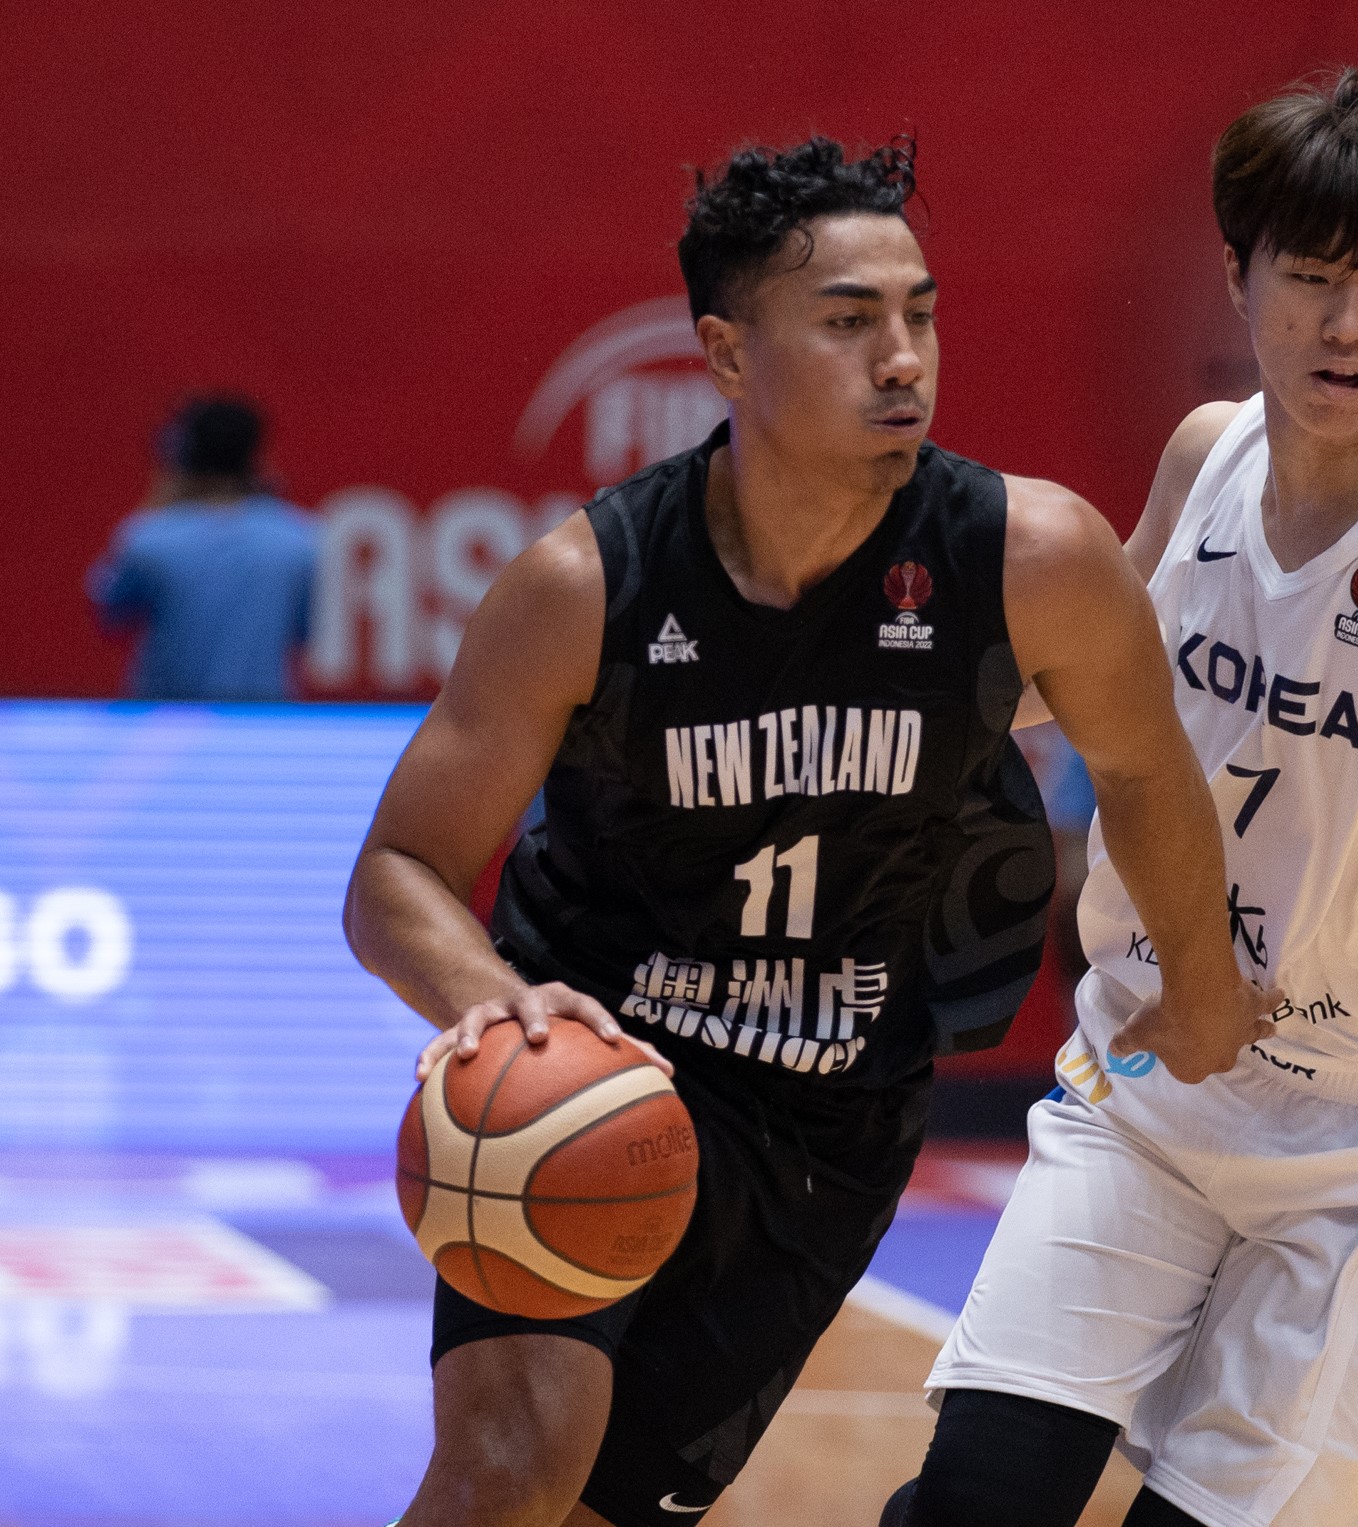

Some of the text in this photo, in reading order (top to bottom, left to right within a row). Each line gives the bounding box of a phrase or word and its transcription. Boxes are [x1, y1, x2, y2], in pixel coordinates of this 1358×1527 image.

[648, 640, 700, 664] PEAK
[878, 639, 934, 649] INDONESIA 2022
[879, 624, 933, 640] ASIA CUP
[665, 704, 922, 809] NEW ZEALAND
[1226, 763, 1282, 839] 7
[734, 835, 820, 939] 11
